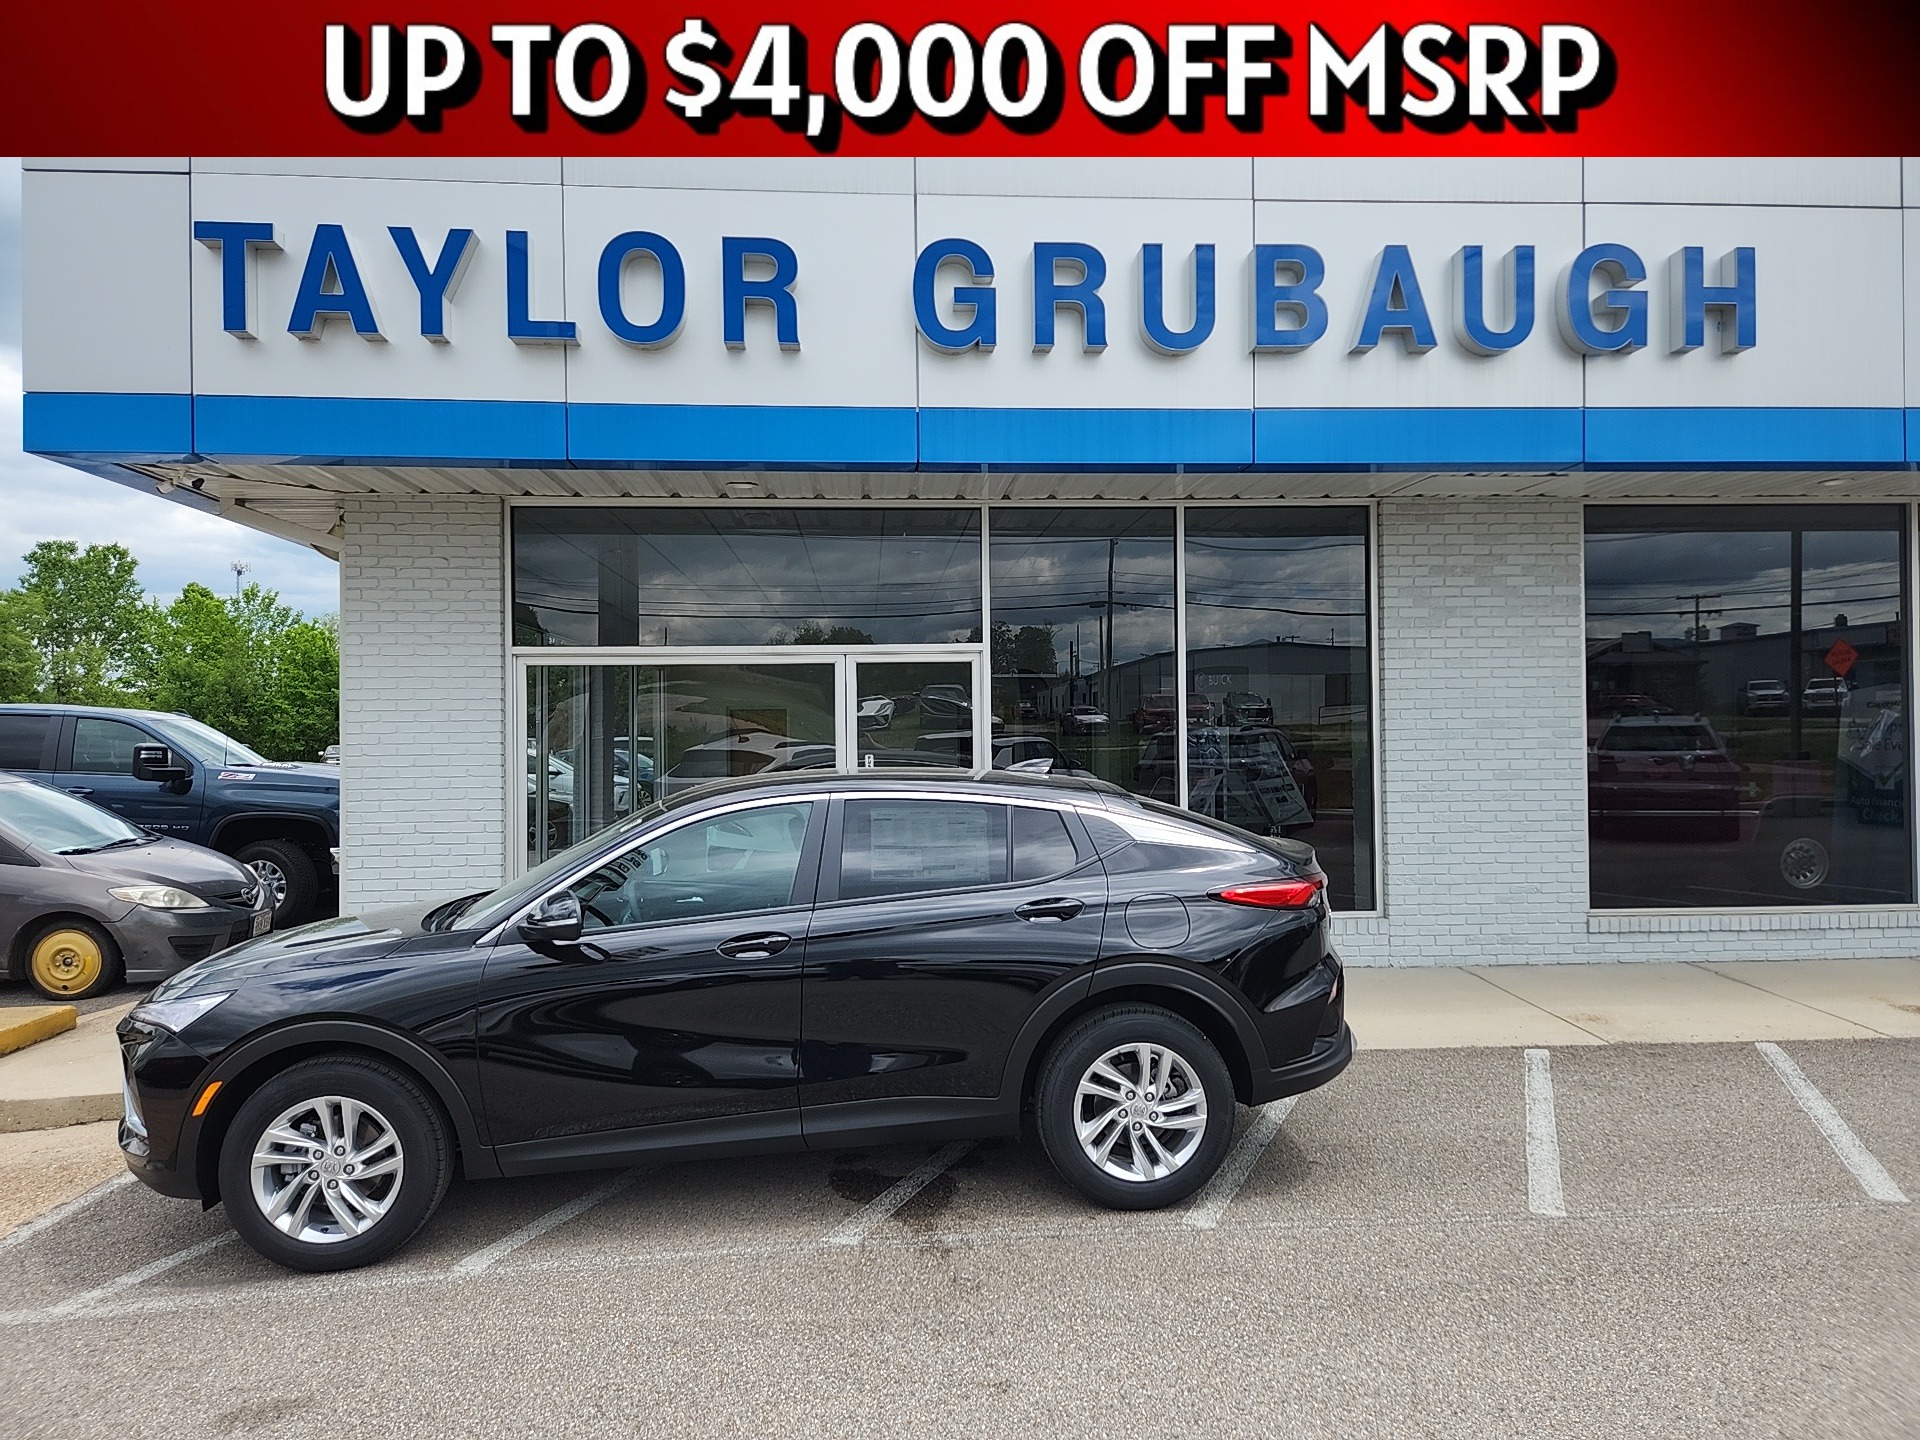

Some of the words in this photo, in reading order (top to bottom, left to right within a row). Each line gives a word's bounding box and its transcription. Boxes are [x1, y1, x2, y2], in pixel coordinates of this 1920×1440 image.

[194, 221, 801, 348] TAYLOR
[911, 239, 1757, 353] GRUBAUGH
[1208, 673, 1233, 686] BUICK
